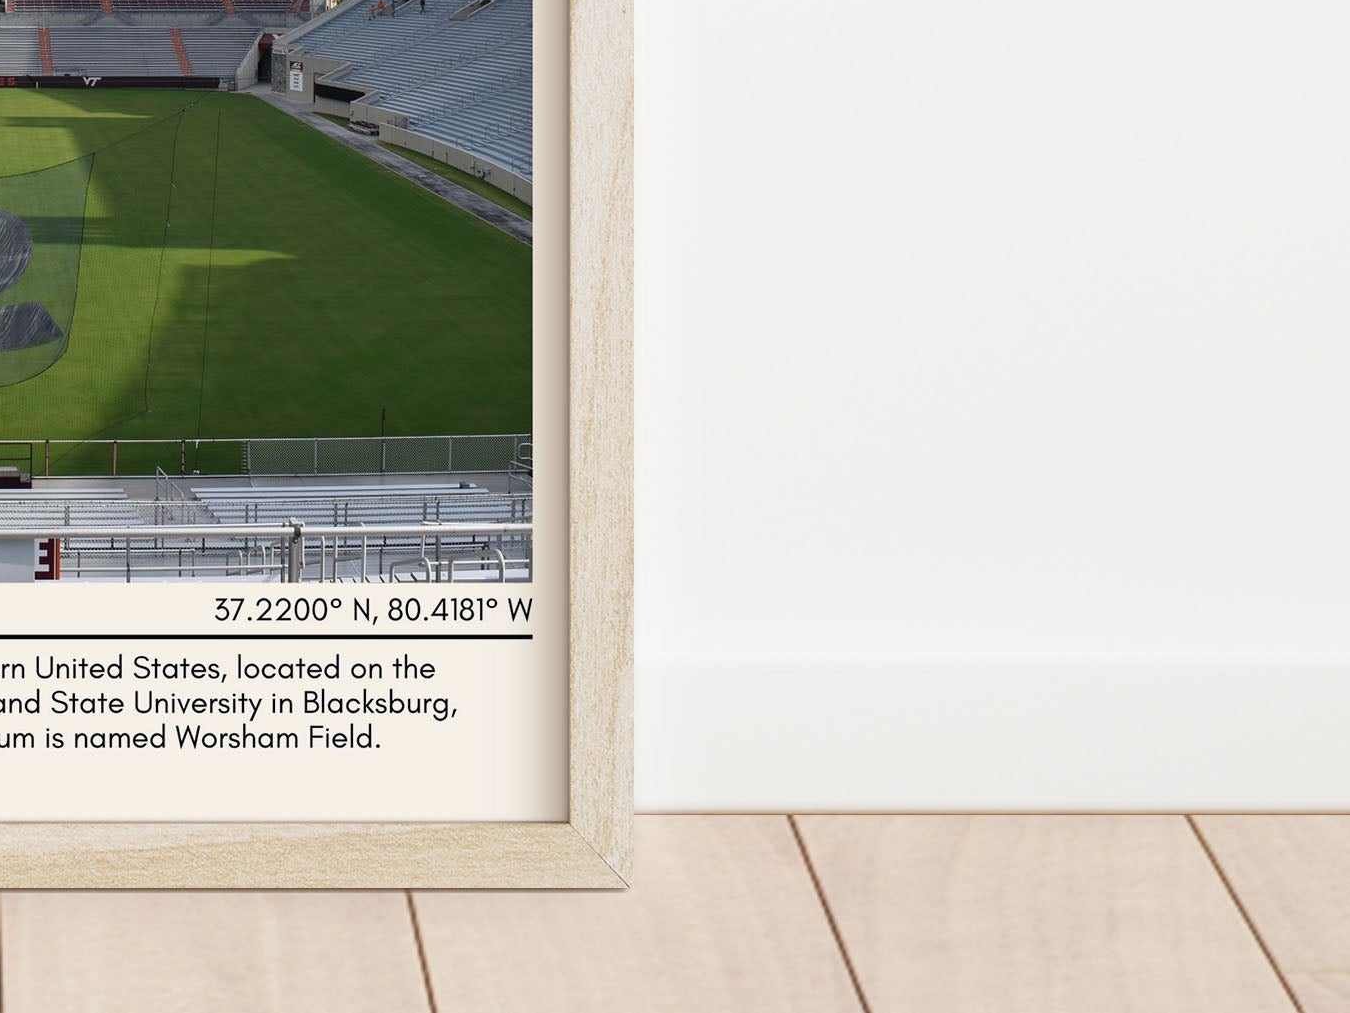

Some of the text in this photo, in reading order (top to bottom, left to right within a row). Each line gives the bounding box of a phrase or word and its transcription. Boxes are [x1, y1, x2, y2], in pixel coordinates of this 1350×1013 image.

[214, 597, 534, 626] 37.2200° N, 80.4181° W
[35, 654, 123, 680] United
[133, 655, 227, 684] States,
[237, 654, 340, 680] located
[350, 664, 383, 679] on
[391, 654, 436, 680] the
[51, 690, 125, 714] State
[134, 690, 263, 721] University
[272, 690, 293, 714] in
[304, 688, 457, 721] Blacksburg,
[45, 725, 65, 749] is
[74, 723, 166, 749] named
[175, 723, 299, 749] Worsham
[309, 723, 381, 749] Field.
